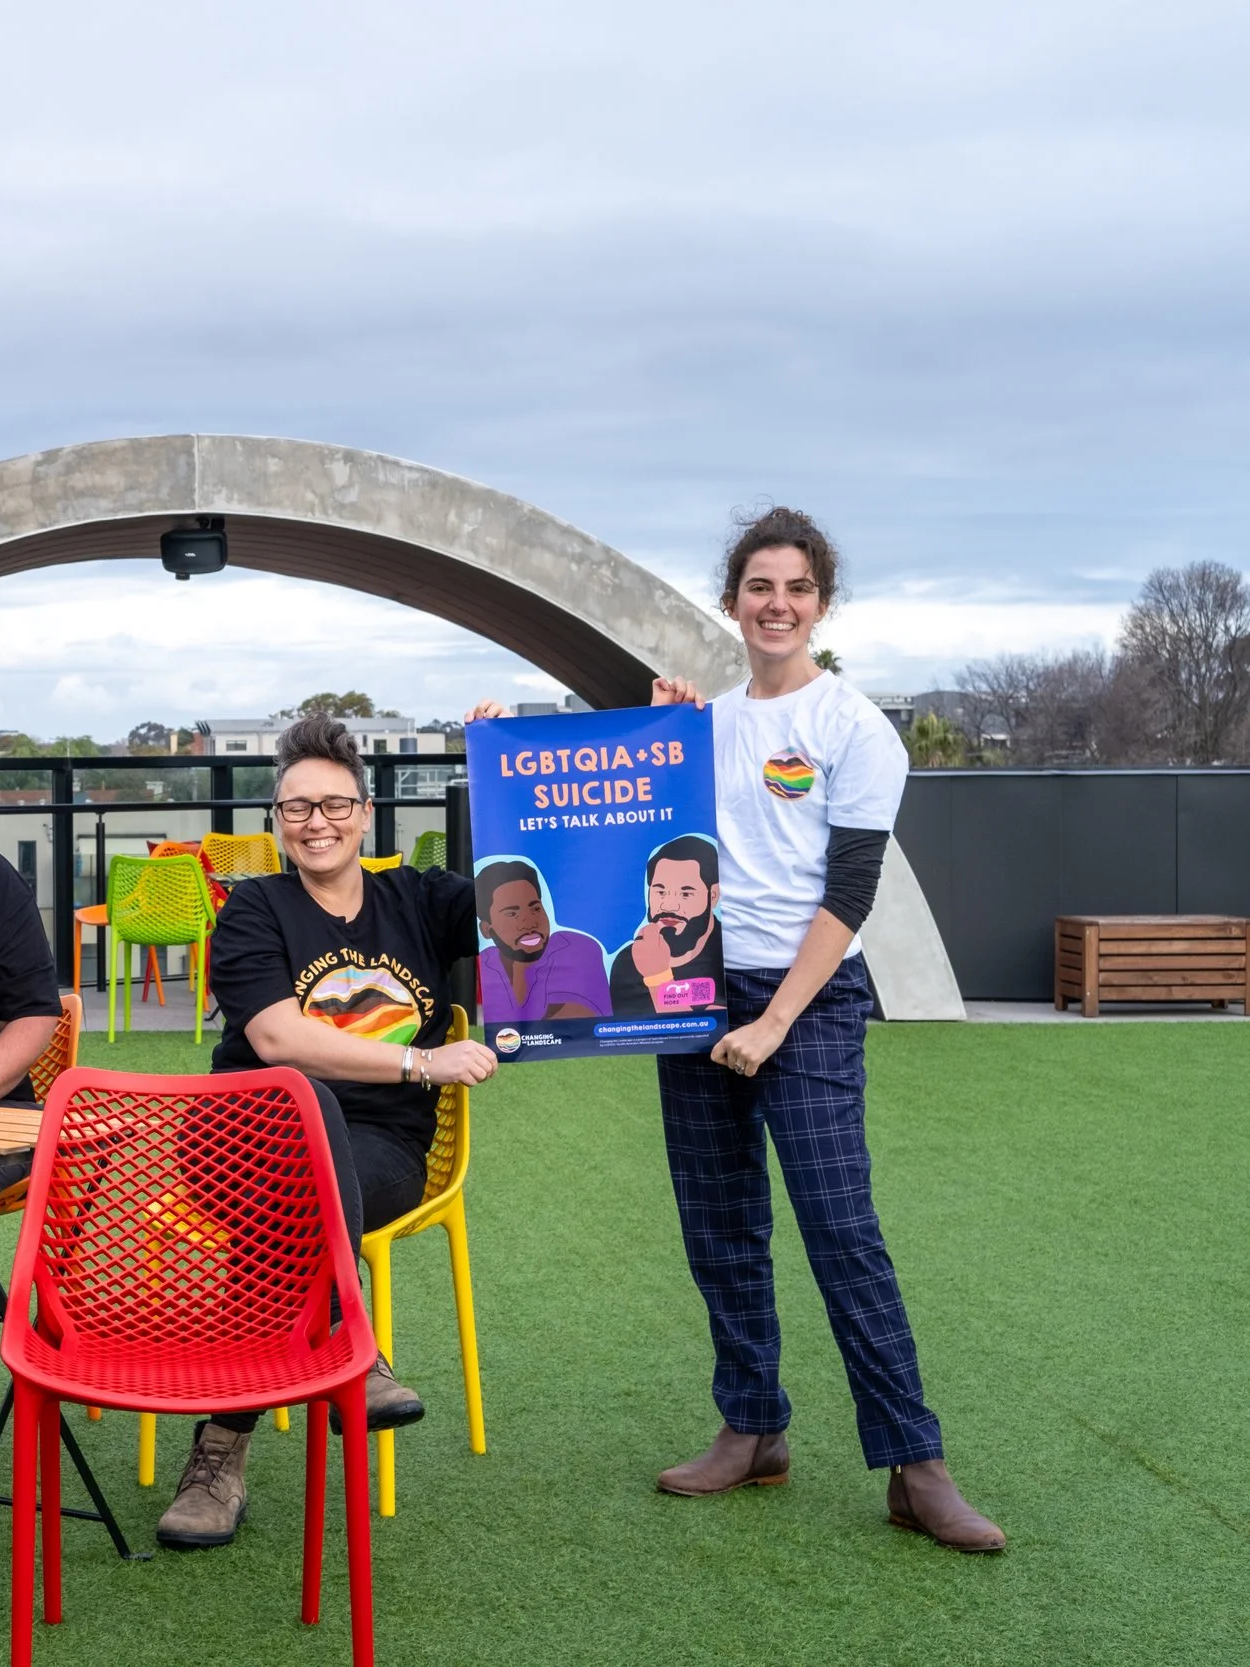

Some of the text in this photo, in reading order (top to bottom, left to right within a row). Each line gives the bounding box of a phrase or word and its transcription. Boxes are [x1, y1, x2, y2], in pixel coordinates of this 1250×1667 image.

[501, 741, 684, 777] LGBTQIA+SB
[534, 777, 652, 809] SUICIDE
[519, 807, 673, 831] LET'S TALK ABOUT IT
[295, 952, 338, 997] NGING
[340, 947, 365, 967] THE
[521, 1033, 554, 1041] CHANGING
[598, 1021, 709, 1033] changingthelandscape.com.au
[527, 1038, 562, 1046] LANDSCAPE
